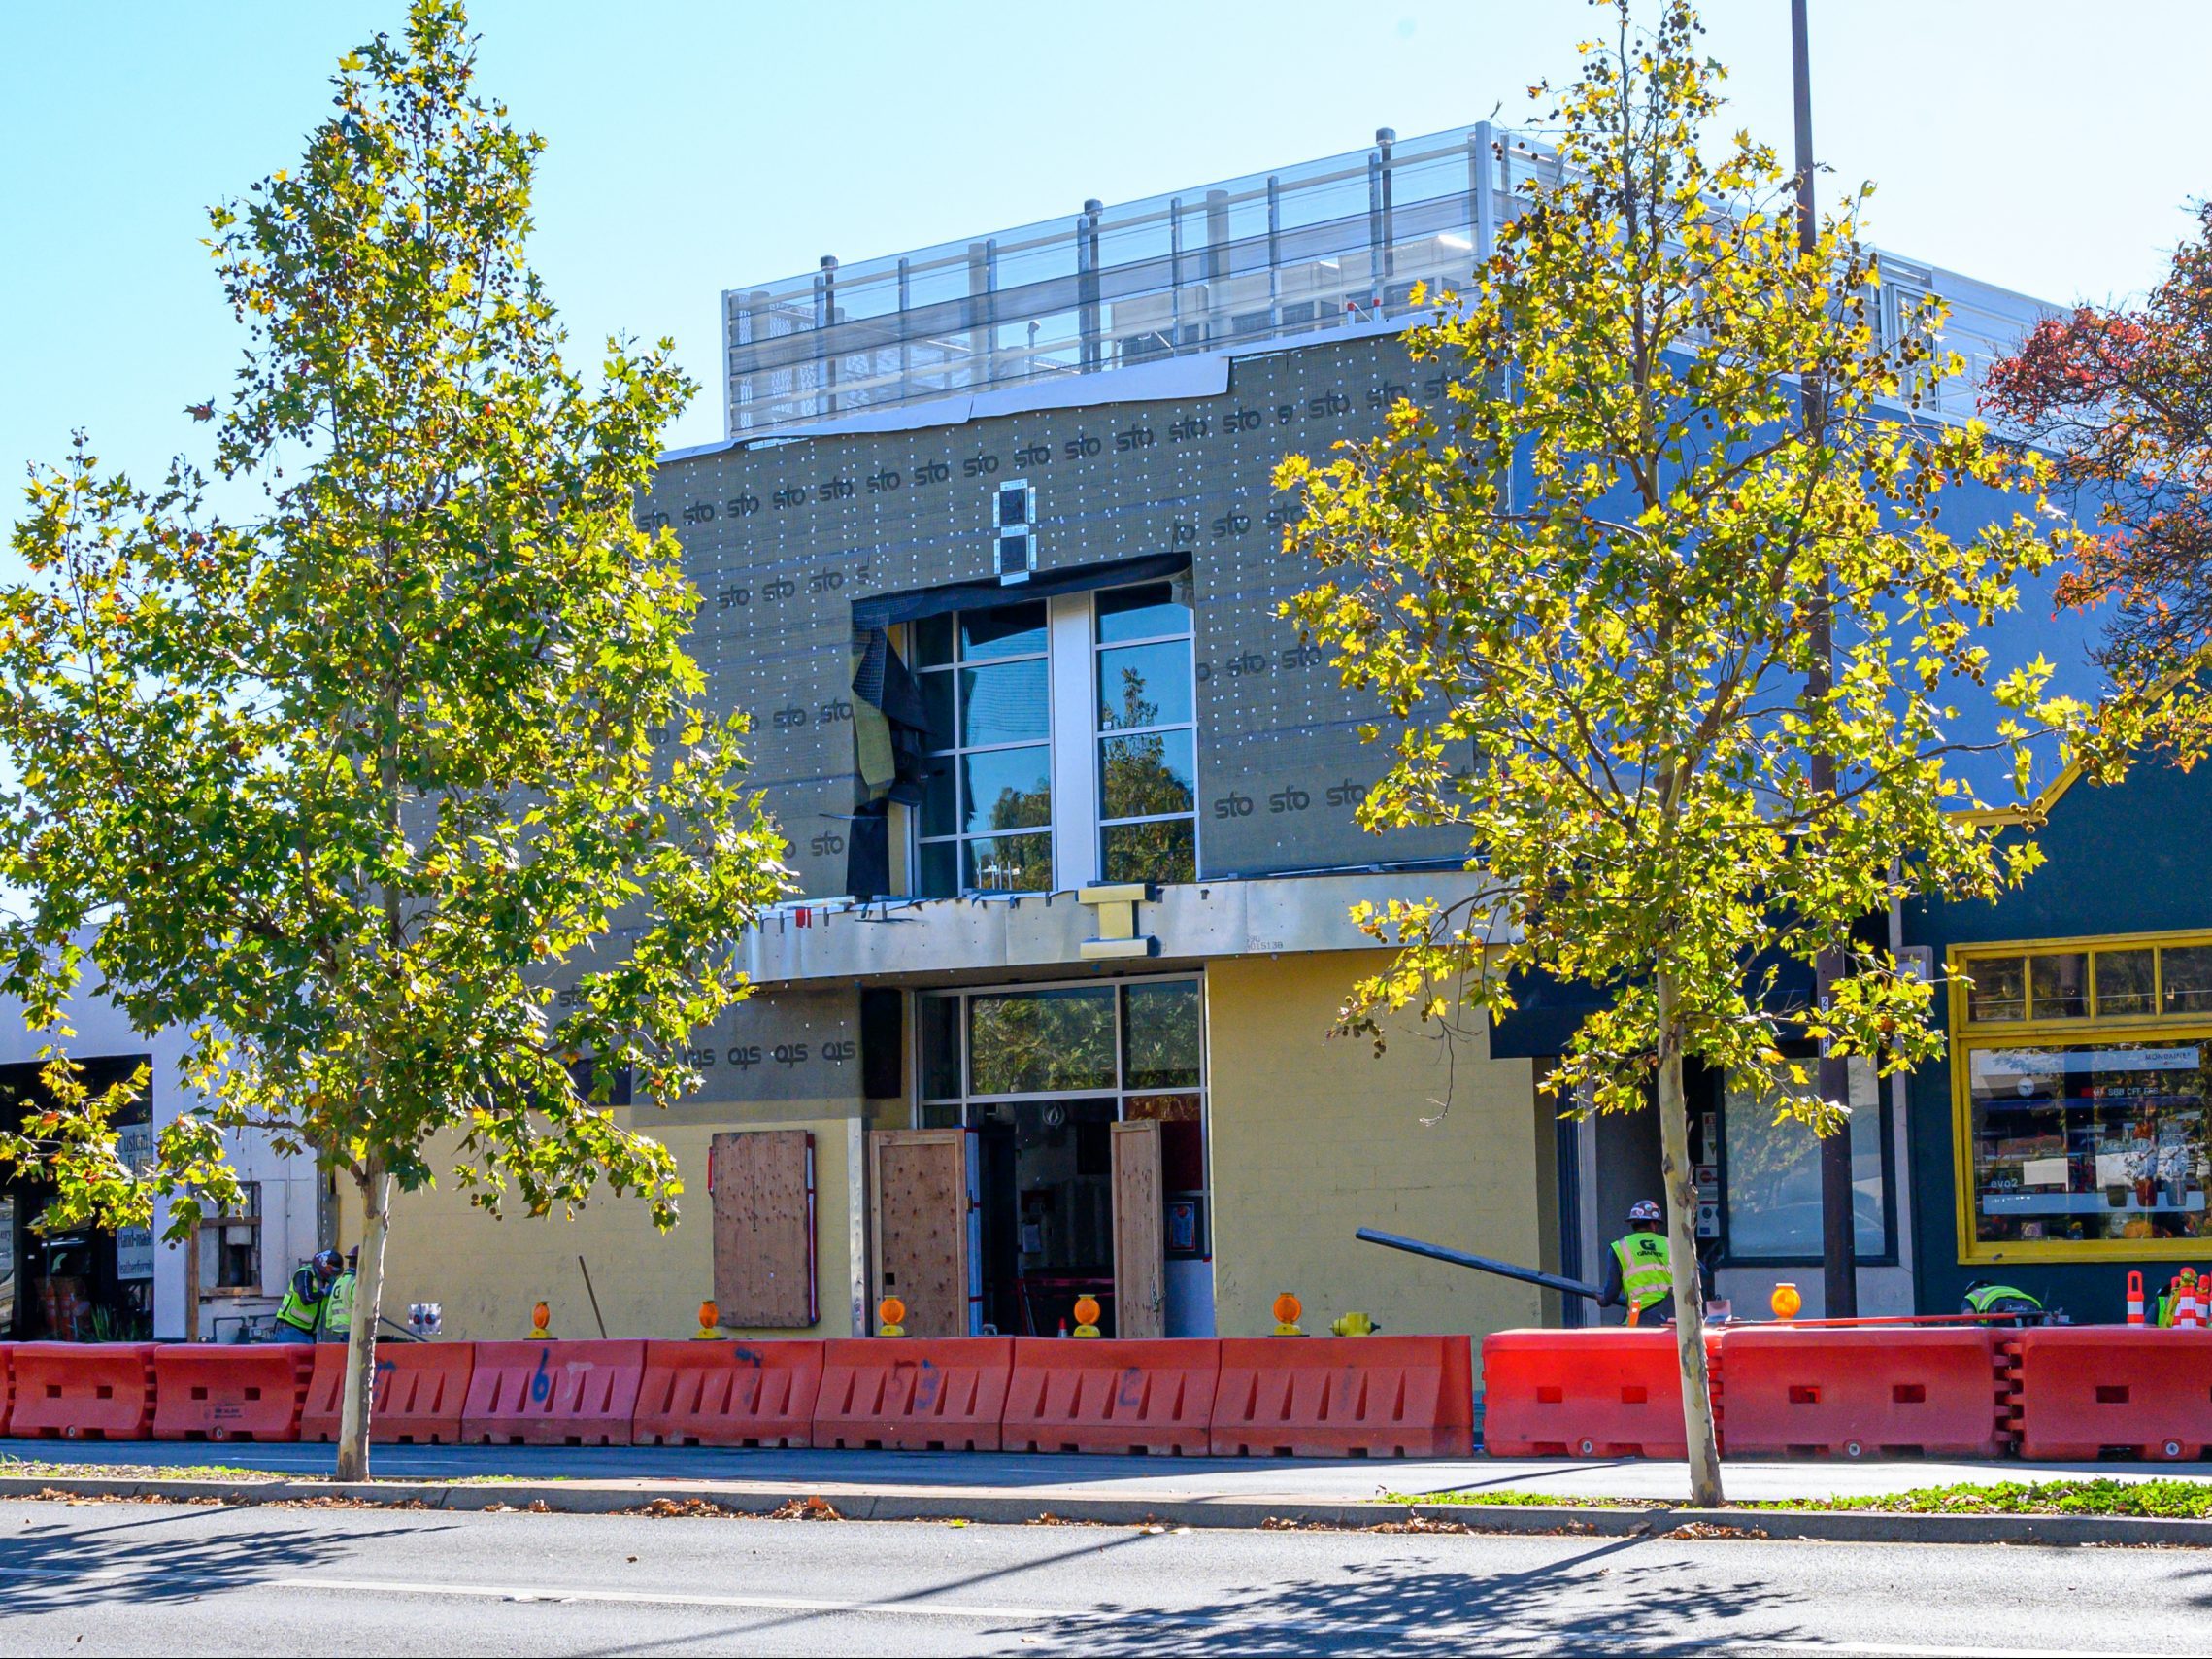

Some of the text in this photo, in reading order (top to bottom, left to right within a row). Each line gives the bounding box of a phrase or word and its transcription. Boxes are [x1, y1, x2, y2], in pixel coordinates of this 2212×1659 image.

[639, 508, 670, 532] sto
[683, 500, 715, 525] sto
[727, 491, 759, 518] sto
[772, 484, 806, 509] sto
[819, 476, 853, 503] sto
[867, 467, 900, 494] sto
[914, 458, 949, 486] sto
[963, 452, 999, 477] sto
[1014, 443, 1050, 470] sto
[1065, 434, 1101, 460] sto
[1116, 424, 1154, 451] sto
[1168, 414, 1207, 441] sto
[1223, 406, 1261, 435] sto
[1309, 389, 1350, 419] sto
[1212, 510, 1251, 538] sto
[719, 584, 750, 610] sto
[761, 573, 795, 602] sto
[810, 566, 844, 593] sto
[1226, 650, 1265, 678] sto
[1282, 643, 1322, 670] sto
[773, 702, 806, 728] sto
[820, 696, 854, 723] sto
[1215, 778, 1367, 819] sto sto sto
[811, 830, 845, 857] sto
[1991, 1178, 2019, 1188] evo2
[532, 1347, 550, 1404] 6
